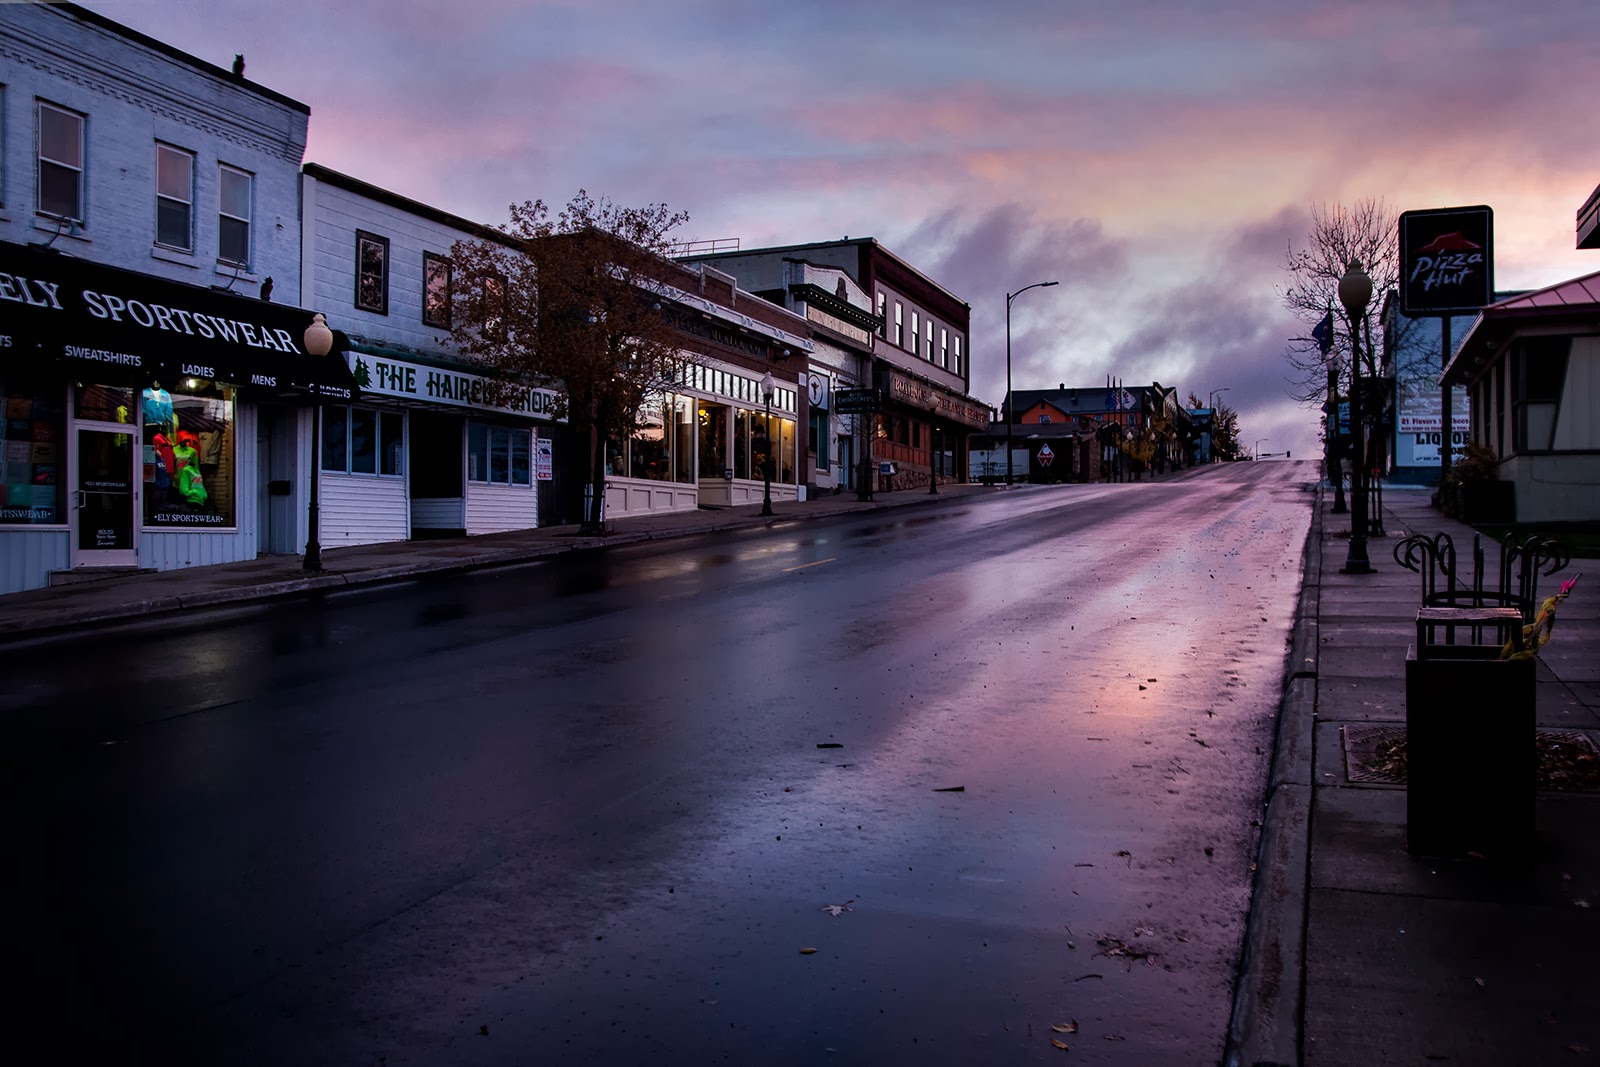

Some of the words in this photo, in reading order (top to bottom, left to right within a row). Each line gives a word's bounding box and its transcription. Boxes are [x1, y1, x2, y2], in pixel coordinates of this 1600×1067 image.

[1410, 248, 1483, 284] Pizza
[1423, 267, 1475, 292] Hut
[0, 271, 64, 310] ELY
[80, 289, 301, 354] SPORTSWEAR
[64, 344, 142, 367] SWEATSHIRTS
[181, 362, 215, 379] LADIES
[251, 373, 277, 388] MENS
[308, 382, 352, 400] CILDRENS
[376, 362, 417, 394] THE
[1416, 432, 1471, 445] LIQOR
[157, 513, 171, 522] ELY
[172, 514, 221, 523] SPORTSWEAR
